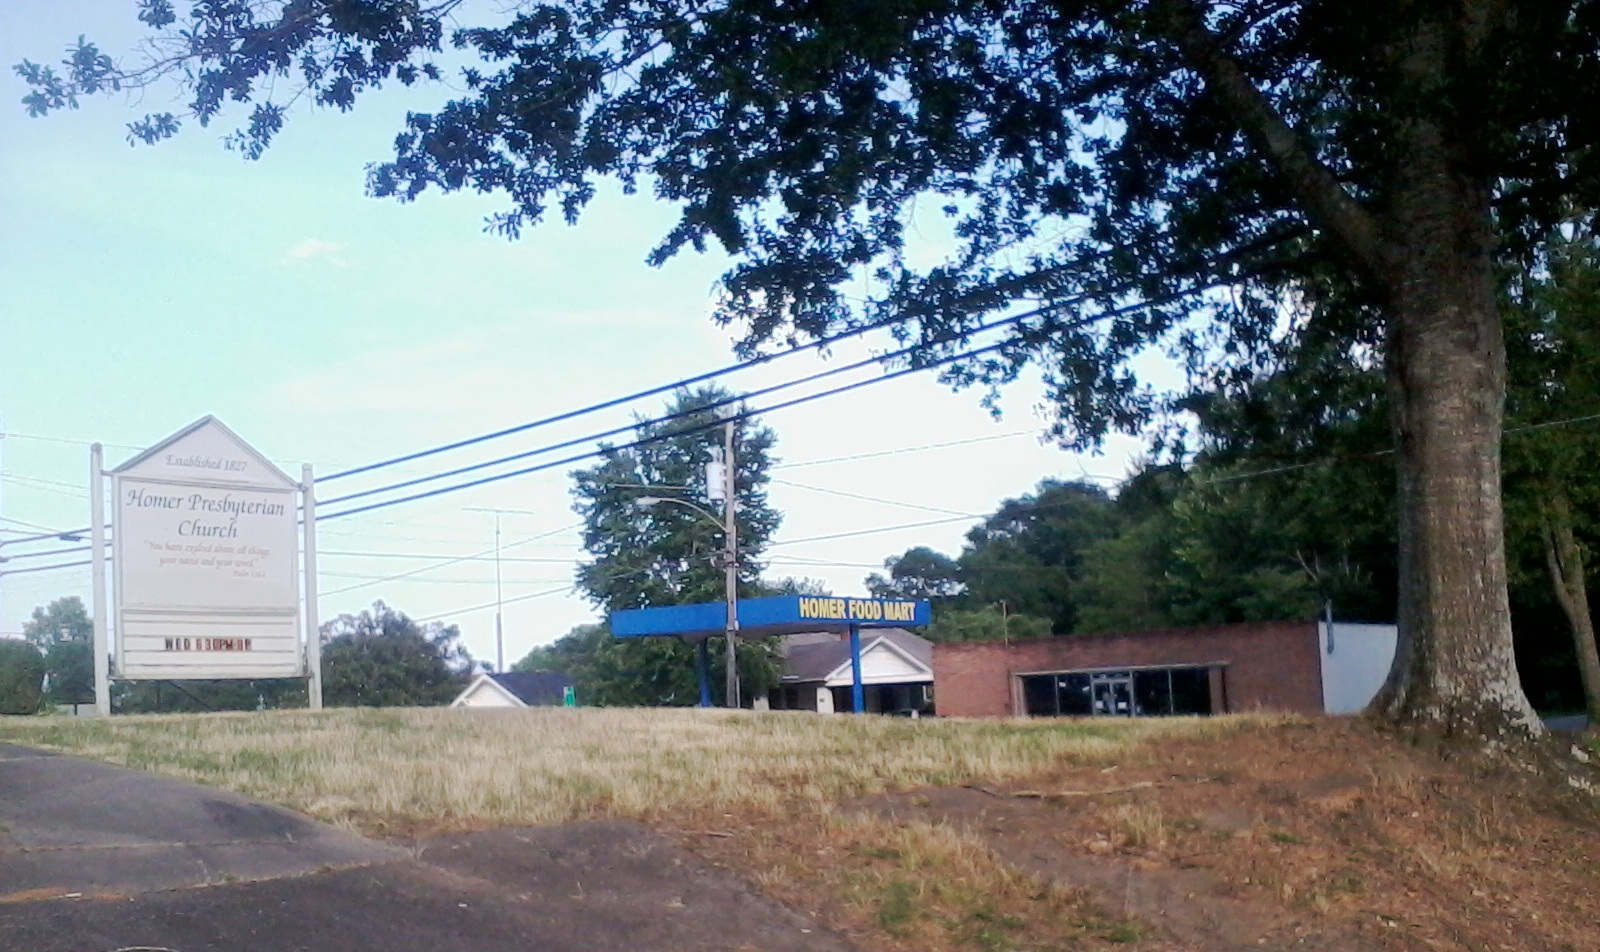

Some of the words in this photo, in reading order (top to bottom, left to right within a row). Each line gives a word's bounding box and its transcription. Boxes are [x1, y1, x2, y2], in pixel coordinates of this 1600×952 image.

[225, 460, 247, 472] 1827
[126, 488, 183, 509] Homer
[188, 493, 284, 520] Presbyterian
[178, 518, 238, 538] Church
[799, 597, 847, 619] HOMER
[848, 600, 881, 619] FOOD
[884, 601, 916, 621] MART
